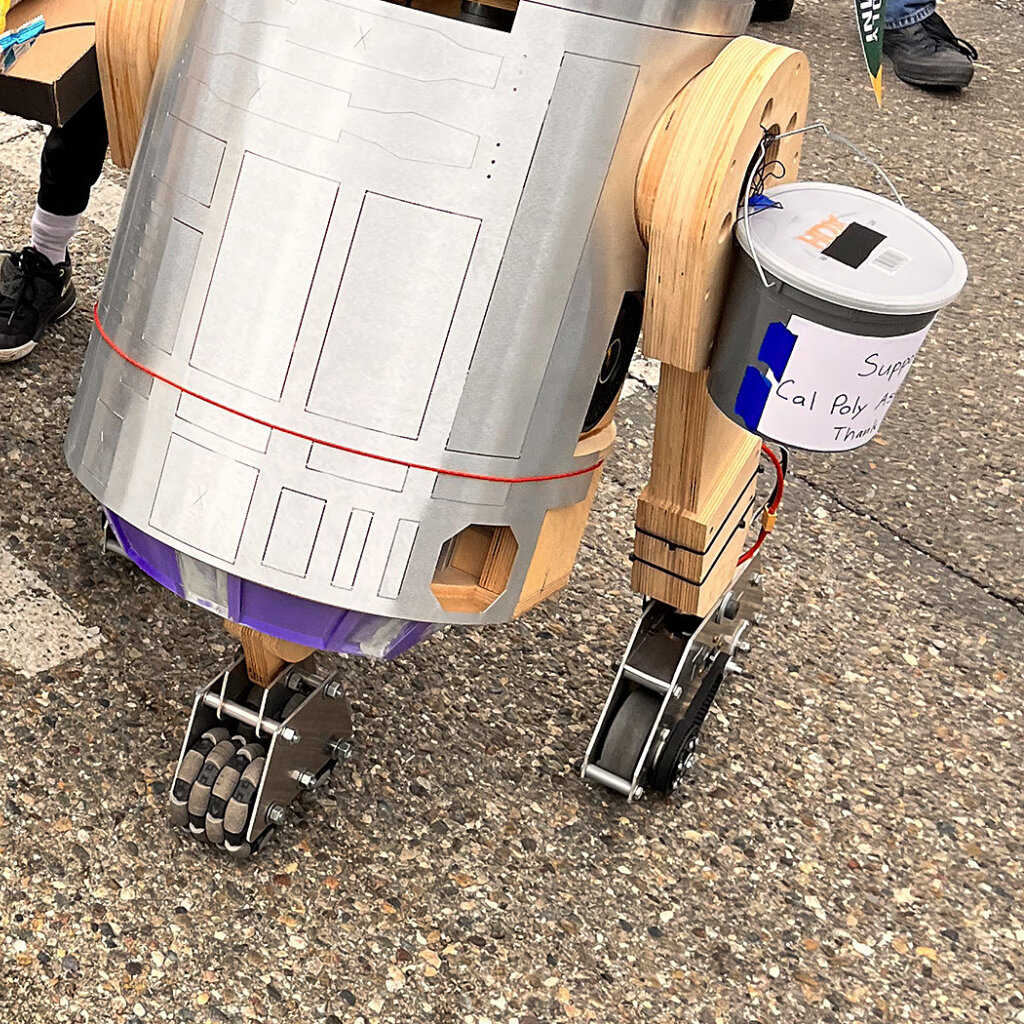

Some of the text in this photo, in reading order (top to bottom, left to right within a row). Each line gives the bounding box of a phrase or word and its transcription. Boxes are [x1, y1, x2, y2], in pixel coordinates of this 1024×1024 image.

[857, 353, 915, 382] Supp
[776, 379, 817, 411] Cal
[830, 393, 869, 420] Poly
